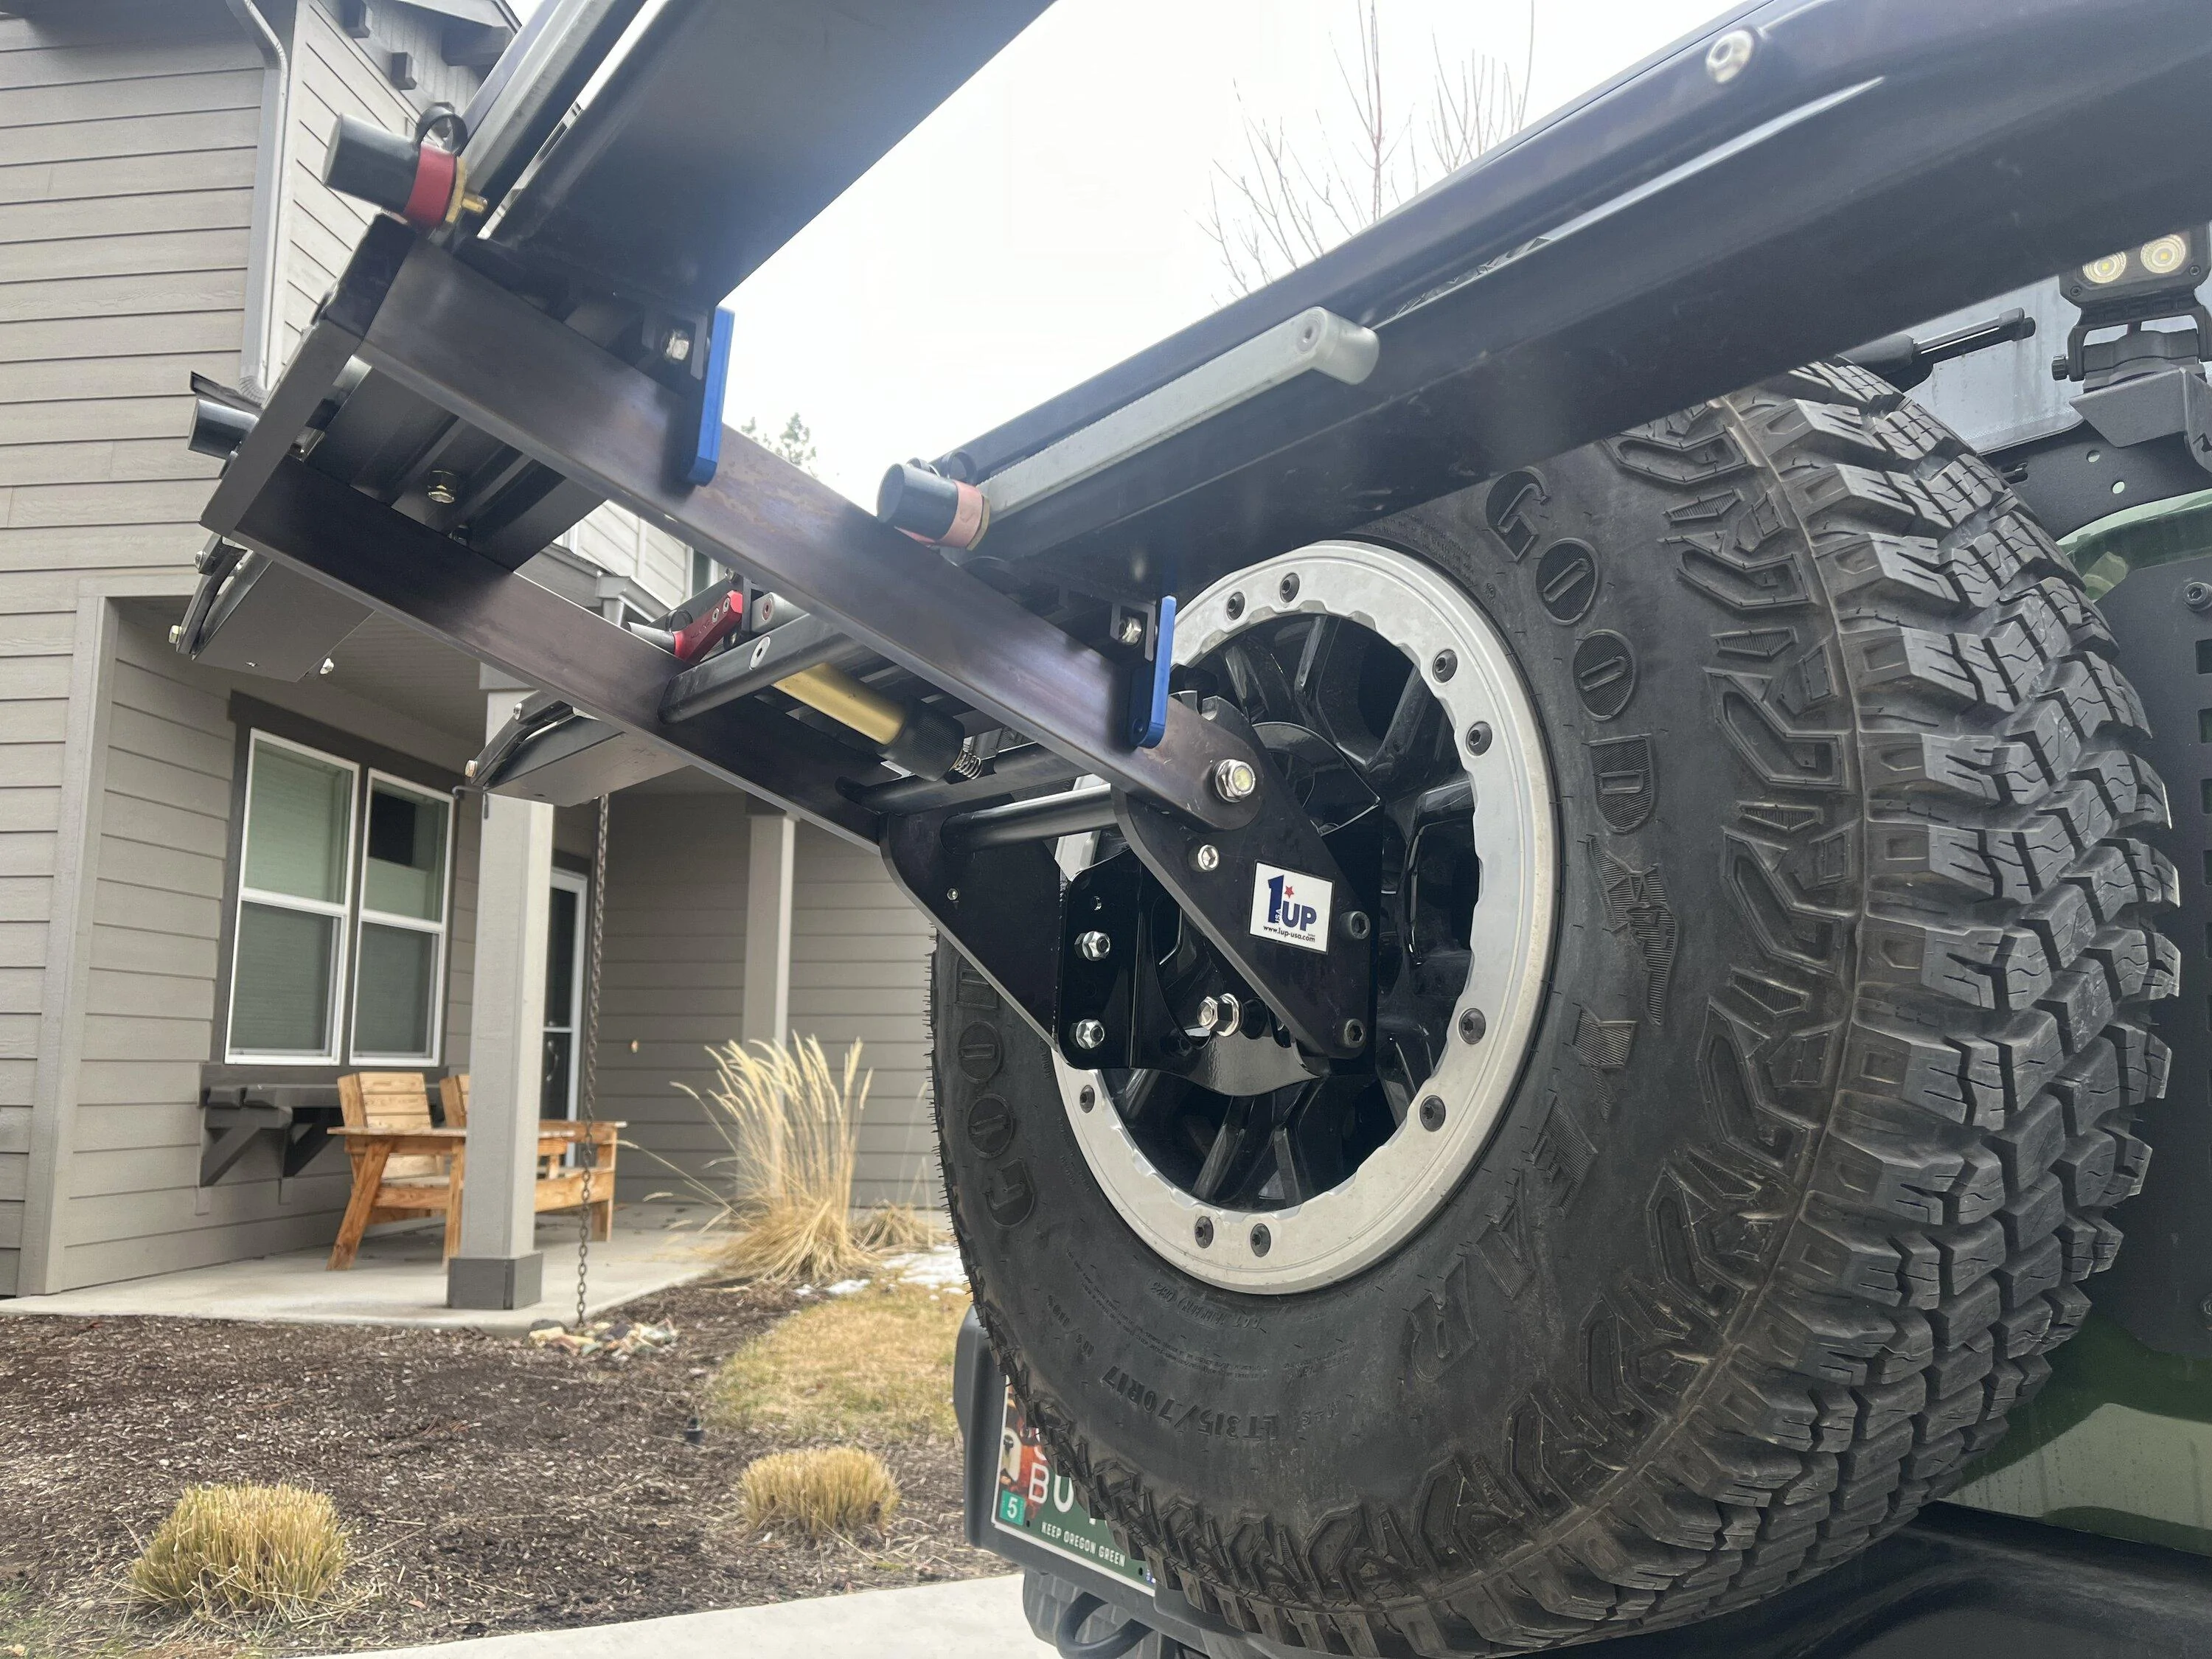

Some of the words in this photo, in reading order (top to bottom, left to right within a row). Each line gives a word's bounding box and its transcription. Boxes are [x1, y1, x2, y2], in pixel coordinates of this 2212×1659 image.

[1262, 925, 1315, 942] www.1up-usa.com
[1006, 1496, 1018, 1519] 5
[1041, 1521, 1061, 1539] KEEP
[1063, 1531, 1096, 1554] OREGON
[1098, 1545, 1126, 1567] GREEN
